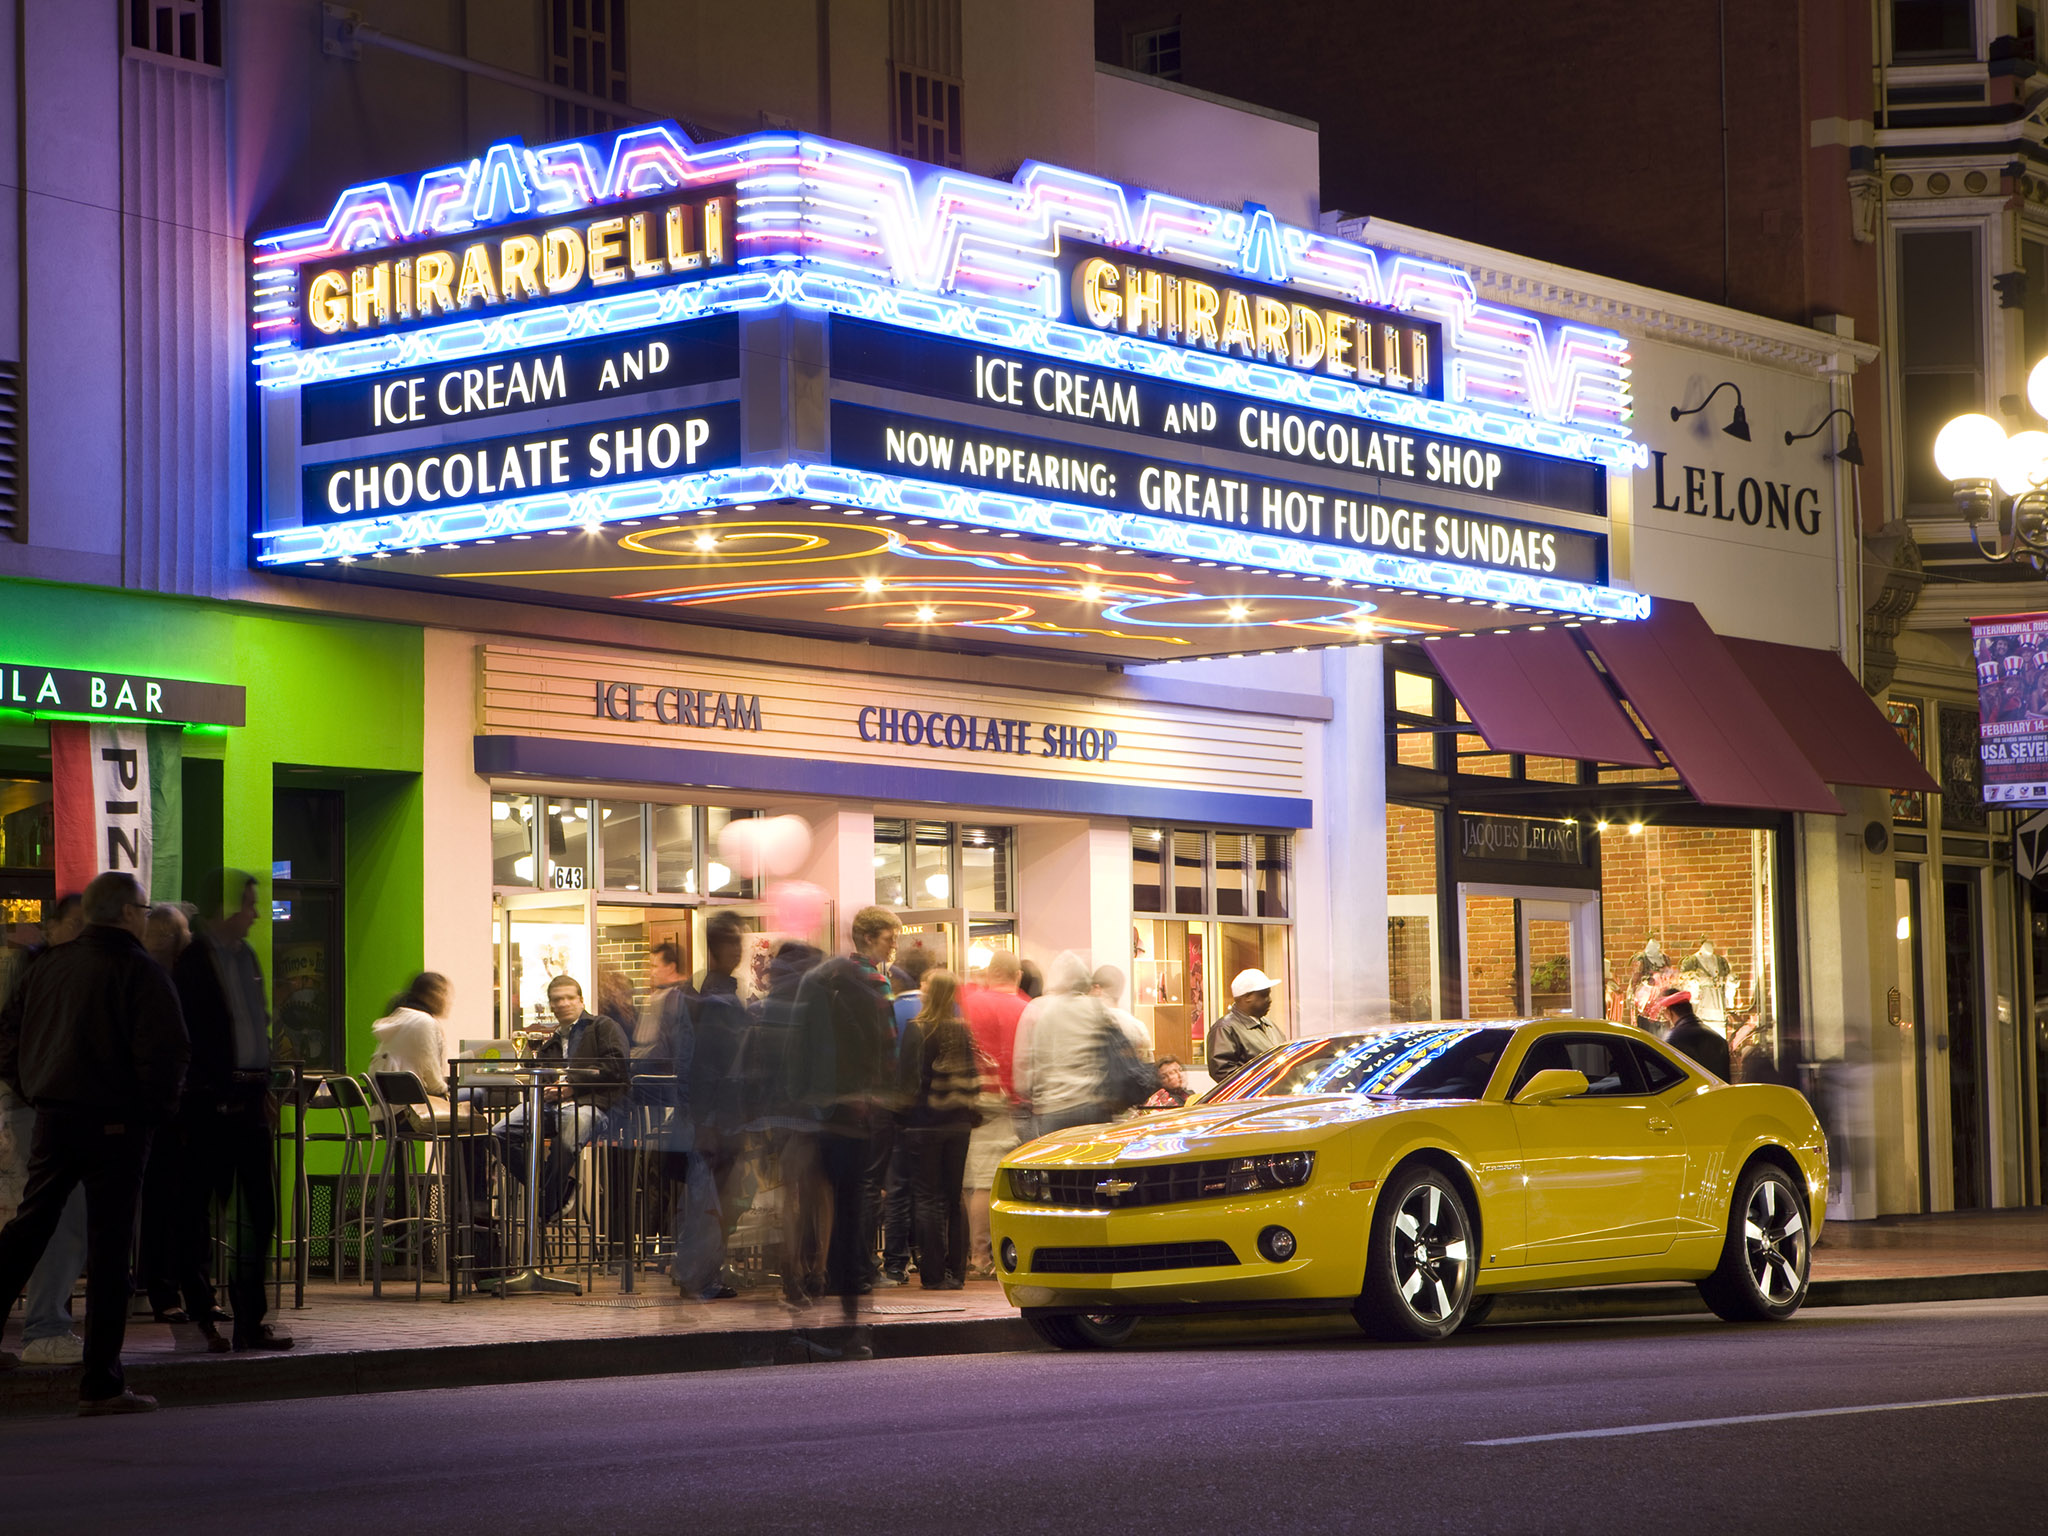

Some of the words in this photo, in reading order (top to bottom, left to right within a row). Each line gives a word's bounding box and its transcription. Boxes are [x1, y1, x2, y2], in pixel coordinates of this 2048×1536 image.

[308, 196, 725, 335] GHIRARDELLI
[1074, 257, 1429, 393] GHIRARDELLI
[374, 378, 425, 427] ICE
[438, 355, 567, 415] CREAM
[598, 342, 670, 392] AND
[975, 355, 1023, 407] ICE
[1033, 368, 1140, 427] CREAM
[1163, 402, 1217, 434] AND
[1239, 406, 1415, 477] CHOCOLATE
[1426, 442, 1501, 491] SHOP
[327, 438, 570, 515] CHOCOLATE
[589, 418, 711, 479] SHOP
[886, 428, 954, 471] NOW
[960, 442, 1117, 498] APPEARING:
[1139, 466, 1248, 526] GREAT!
[1262, 486, 1325, 537] HOT
[1334, 499, 1427, 553] FUDGE
[1434, 516, 1557, 572] SUNDAES
[1651, 450, 1822, 536] LELONG
[1974, 623, 2031, 636] INTERNATIONAL
[91, 677, 163, 713] BAR
[596, 681, 645, 722] ICE
[656, 687, 763, 732] CREAM
[858, 705, 1032, 755] CHOCOLATE
[1043, 724, 1118, 762] SHOP
[1981, 721, 2031, 737] FEBRUARY
[1981, 744, 2008, 760] USA
[556, 867, 582, 889] 643
[1462, 818, 1519, 855] JACQUES
[1522, 820, 1575, 852] LELONG
